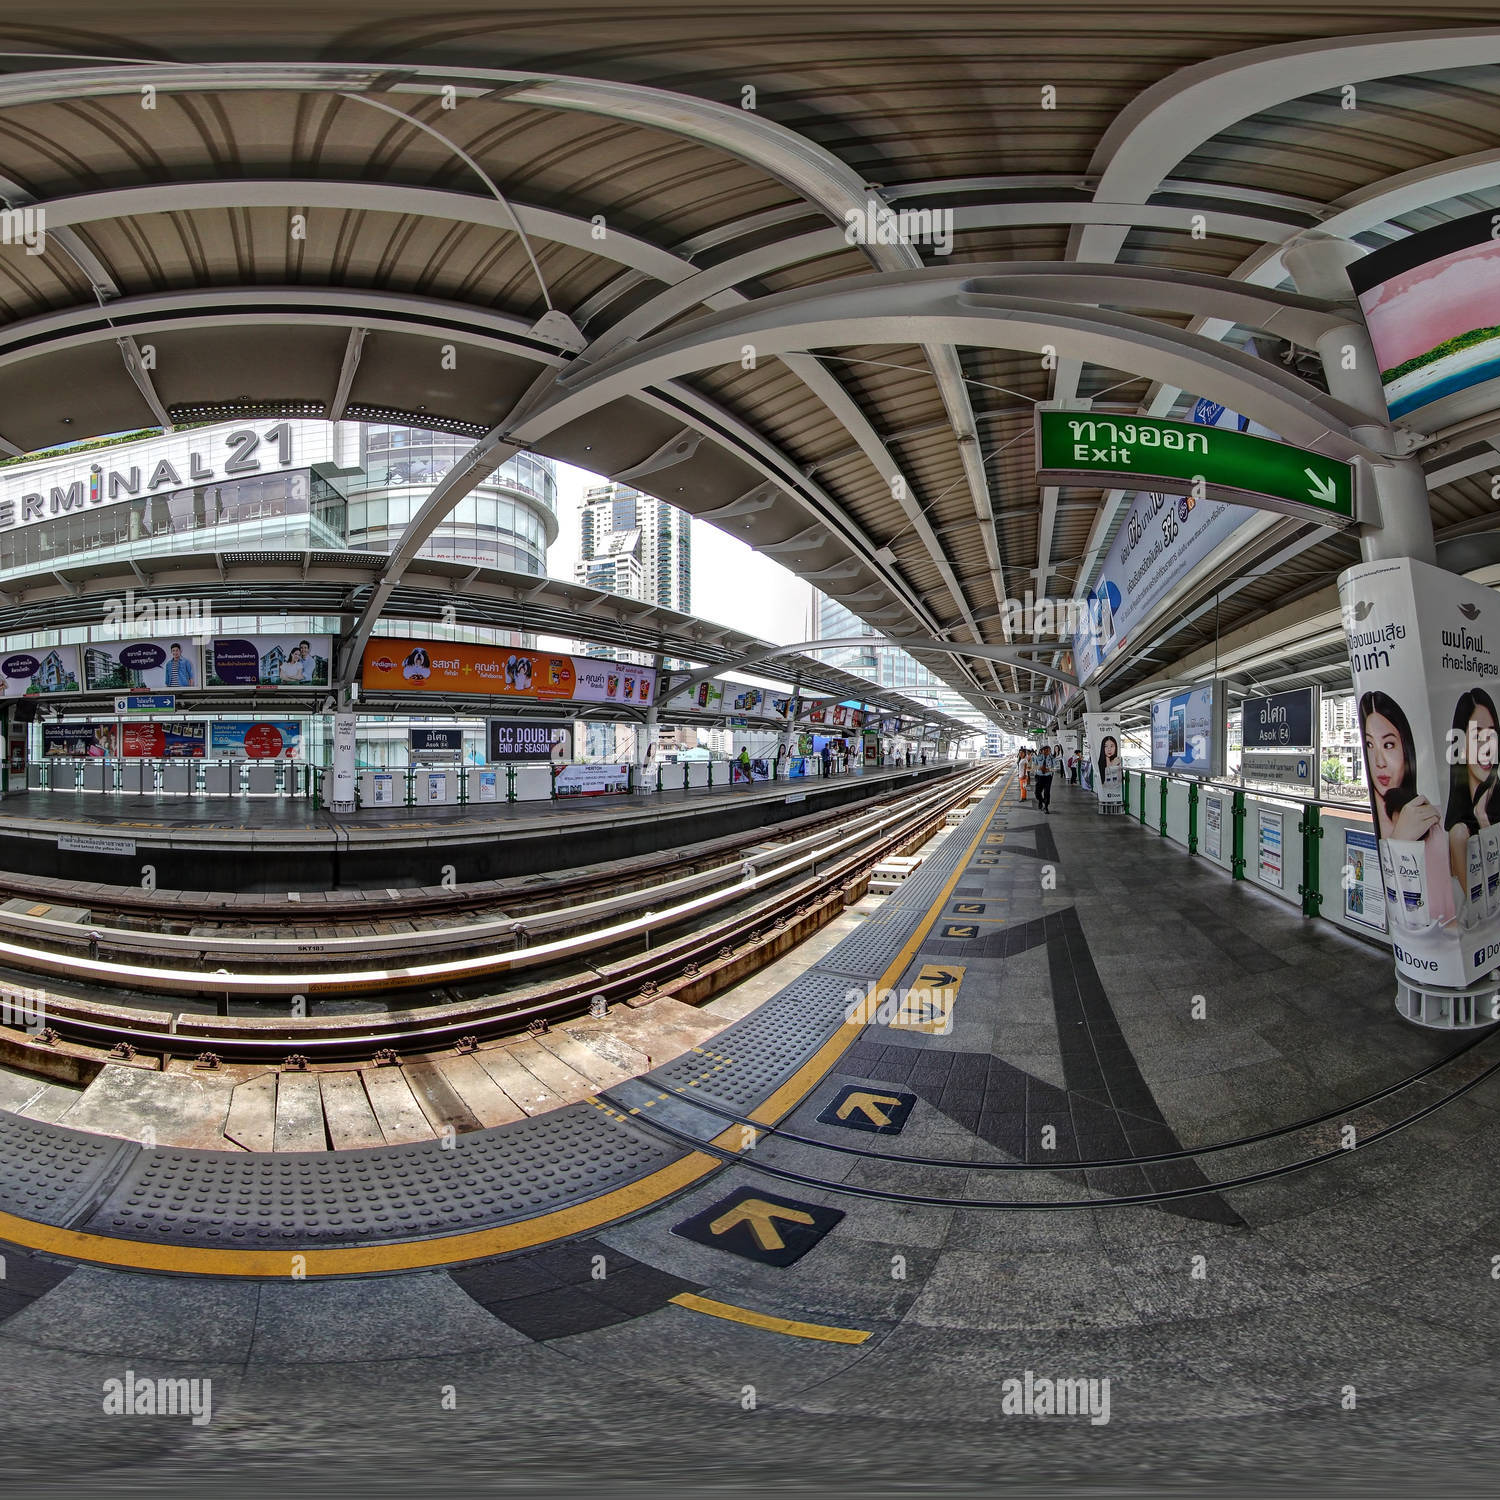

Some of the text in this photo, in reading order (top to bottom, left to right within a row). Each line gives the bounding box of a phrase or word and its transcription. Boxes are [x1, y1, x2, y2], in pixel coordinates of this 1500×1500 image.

[1068, 420, 1208, 455] ทางออก
[225, 422, 292, 475] 21
[1074, 444, 1131, 464] Exit
[1127, 510, 1143, 551] 0%
[432, 658, 460, 670] รสชาติ
[474, 661, 500, 675] คุณค่า
[1350, 654, 1361, 675] 10
[1442, 655, 1499, 679] ทำอะไรก็ดูสวย
[585, 673, 605, 685] คุณค่า
[1260, 697, 1287, 724] อโศก
[427, 730, 447, 742] อโศก
[499, 727, 514, 743] CC
[516, 727, 558, 744] DOUBLE
[1258, 728, 1289, 741] Asok E4
[498, 742, 550, 754] END OF SEASON
[1399, 866, 1420, 876] Dove
[1404, 952, 1439, 972] Dove
